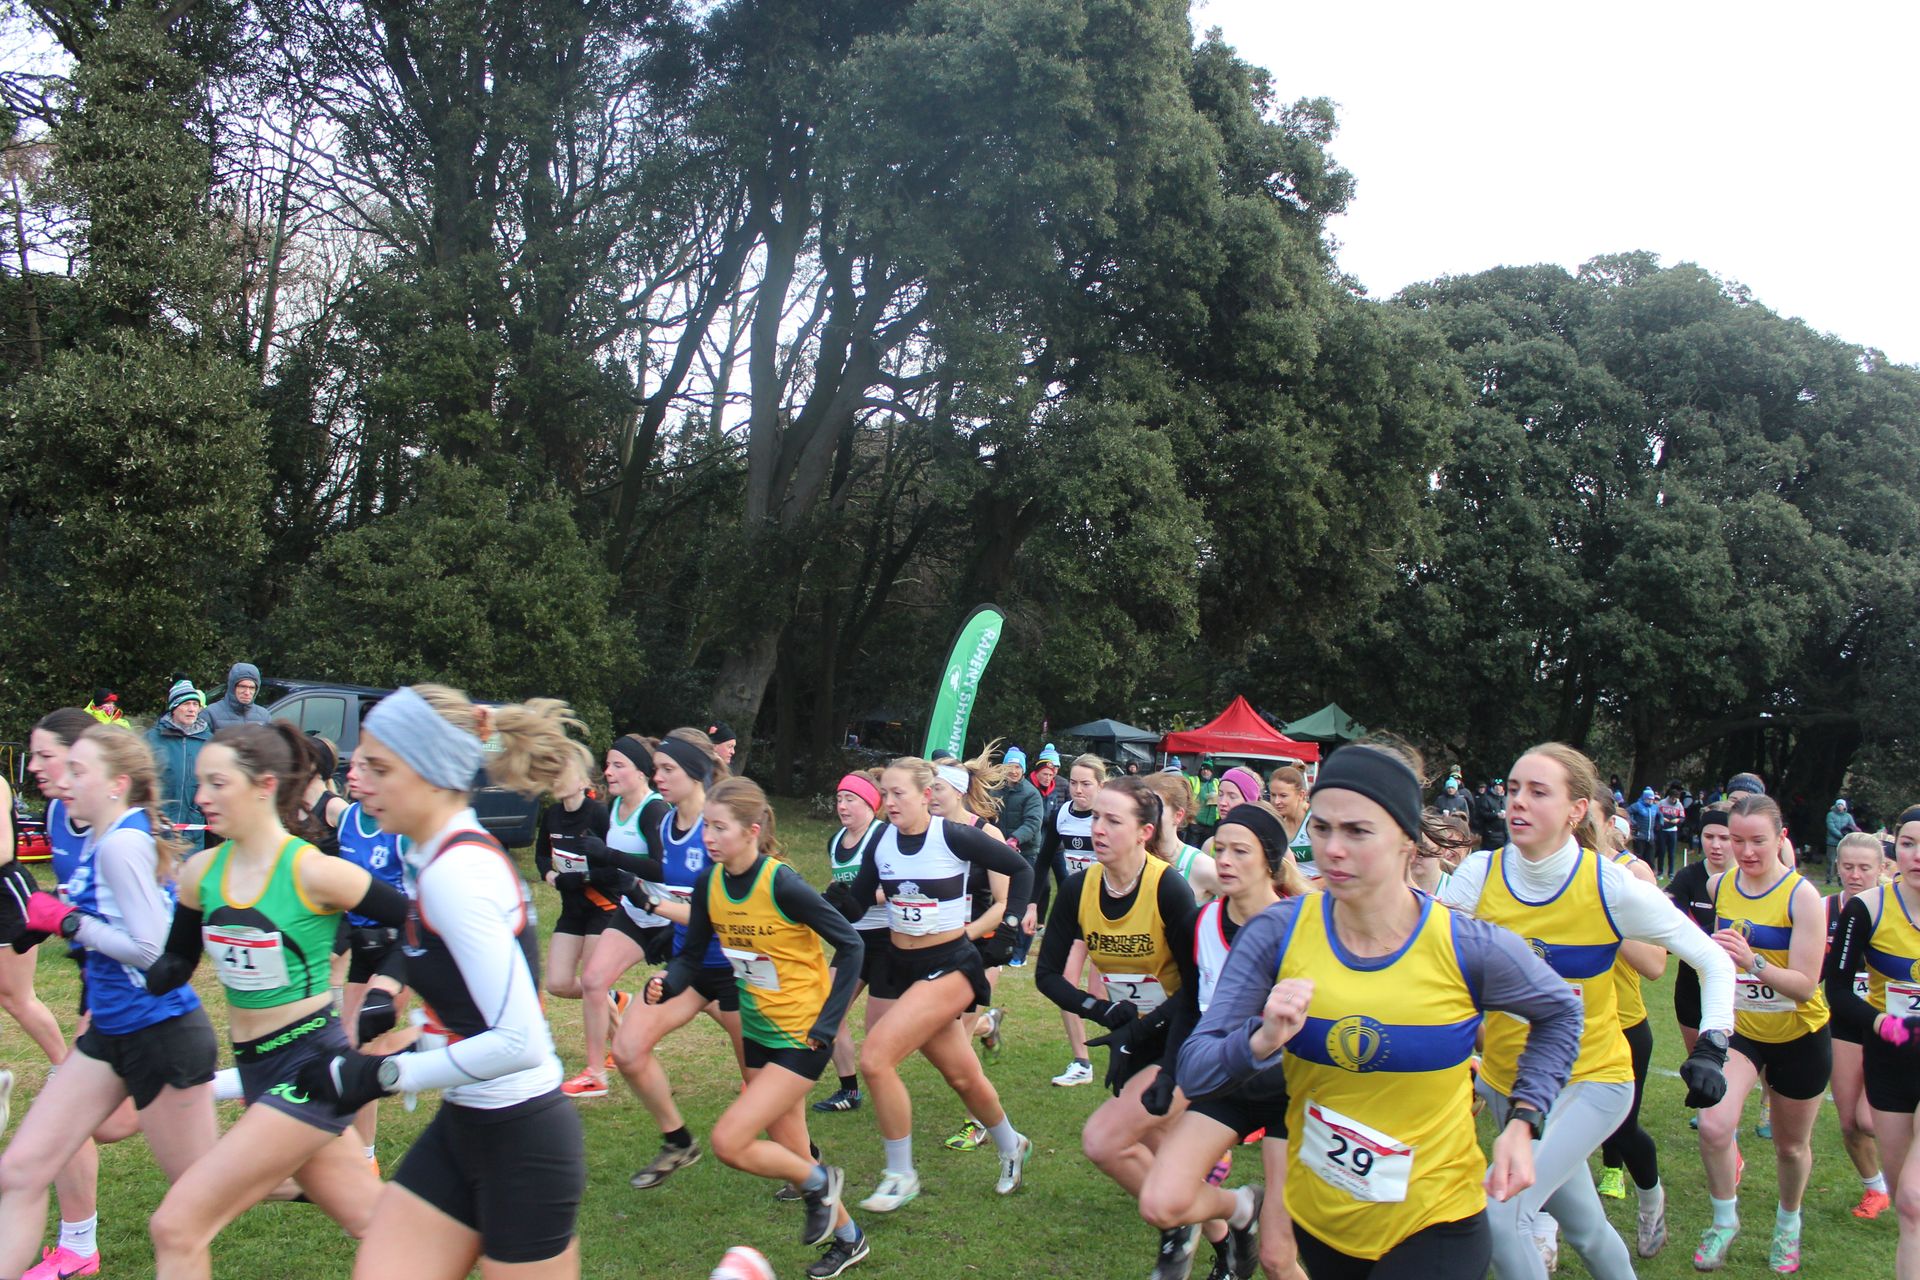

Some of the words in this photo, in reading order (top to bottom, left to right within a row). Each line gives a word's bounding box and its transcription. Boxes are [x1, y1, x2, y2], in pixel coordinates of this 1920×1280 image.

[963, 628, 997, 689] RAHENY
[564, 859, 572, 869] 8
[1071, 861, 1083, 871] 14
[901, 907, 922, 921] 13
[1100, 933, 1151, 945] BROTHERS
[1100, 942, 1135, 953] PEARSE
[223, 946, 257, 970] 41
[741, 960, 753, 975] 1
[1127, 983, 1141, 999] 2
[1746, 984, 1775, 999] 30
[1327, 1133, 1374, 1177] 29
